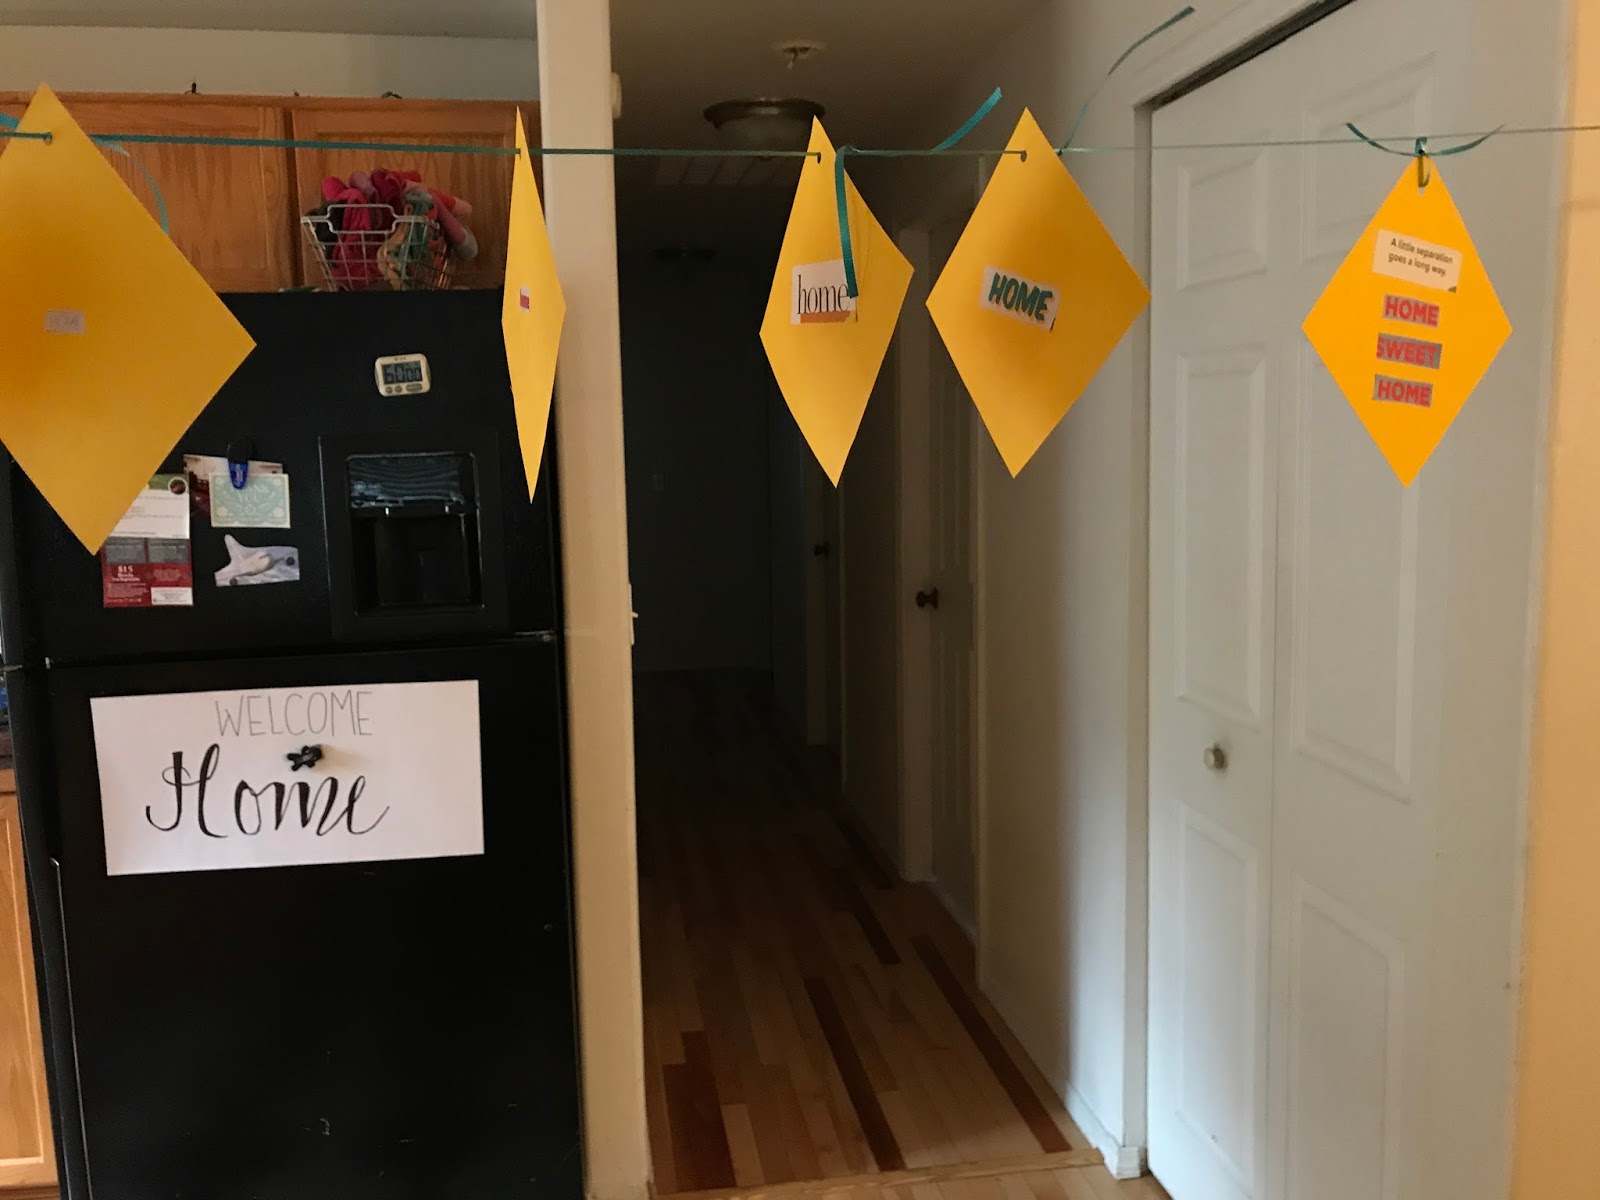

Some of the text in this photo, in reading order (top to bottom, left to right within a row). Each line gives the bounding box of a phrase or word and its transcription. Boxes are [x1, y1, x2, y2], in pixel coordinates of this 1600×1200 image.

[1388, 253, 1407, 264] goes
[1408, 258, 1413, 266] a
[1414, 258, 1430, 273] long
[1390, 238, 1453, 263] A little separation
[797, 274, 850, 314] home
[988, 272, 1053, 321] HOME
[1384, 295, 1439, 327] HOME
[1376, 335, 1436, 365] SWEET
[1377, 379, 1431, 408] HOME
[214, 689, 374, 737] WELCOME
[145, 743, 391, 839] Home
